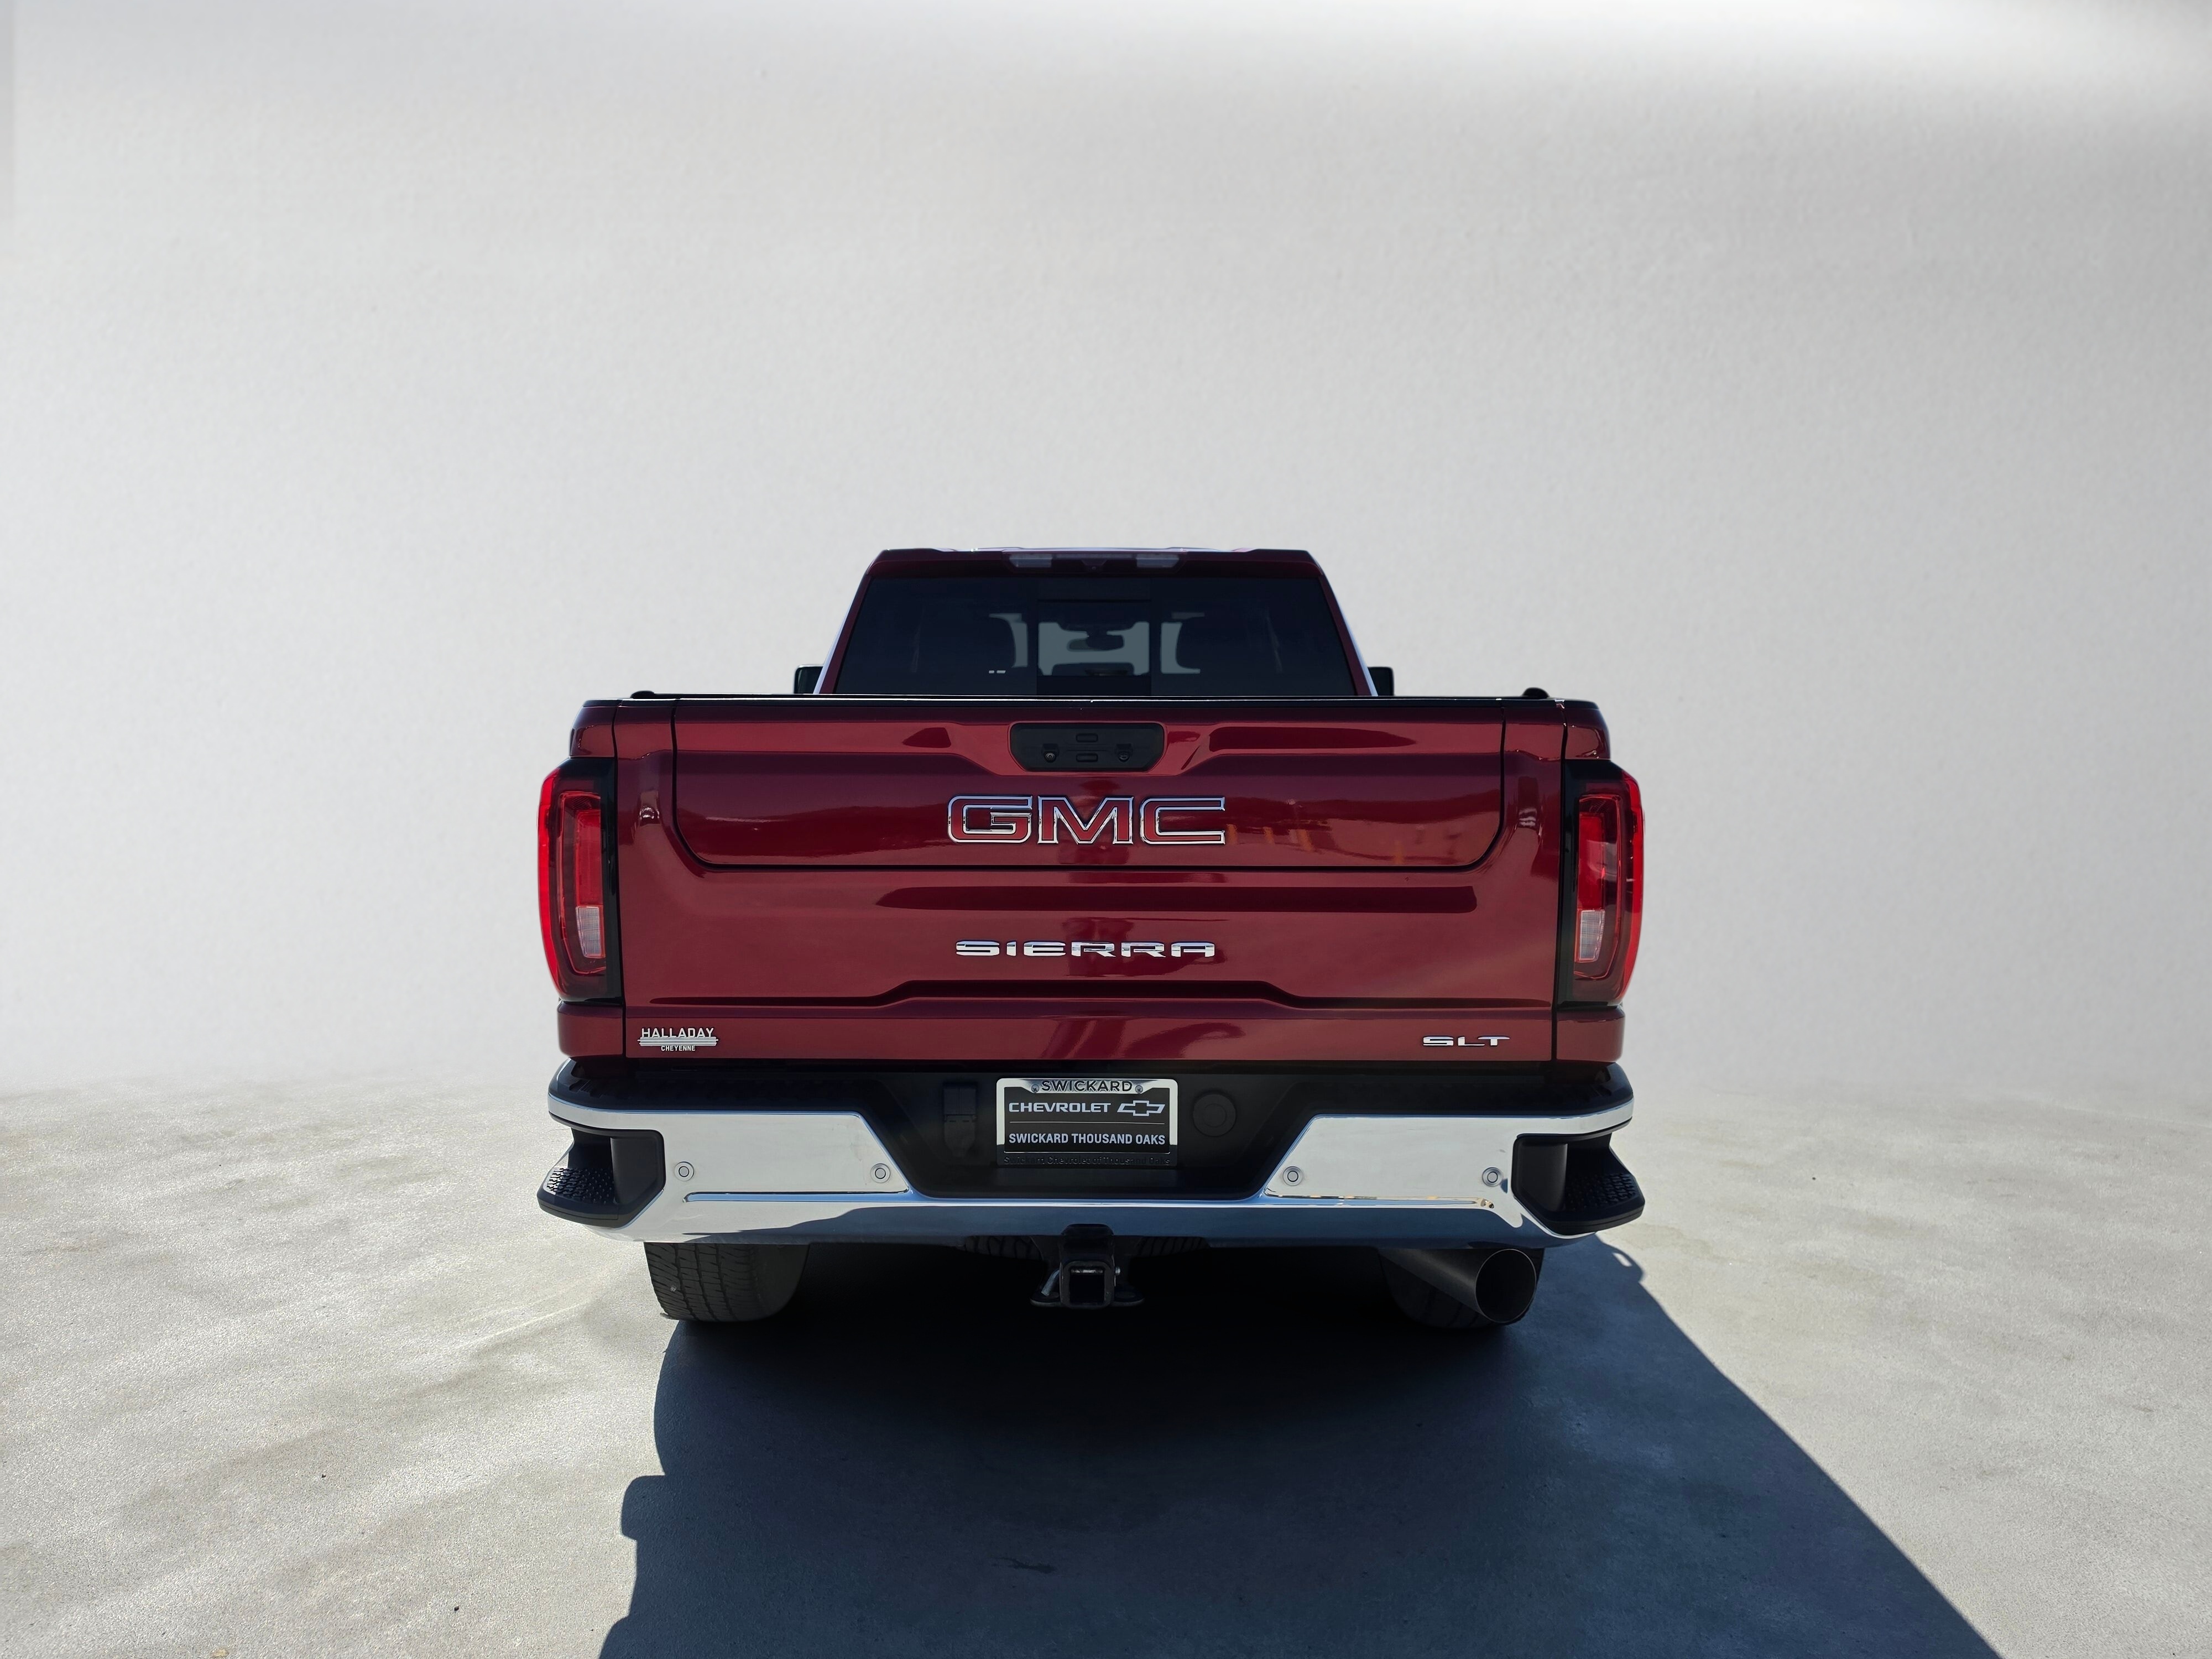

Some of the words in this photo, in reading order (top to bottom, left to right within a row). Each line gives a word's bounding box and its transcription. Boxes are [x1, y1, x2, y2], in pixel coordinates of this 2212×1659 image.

[947, 795, 1225, 845] GMC
[956, 941, 1215, 958] SIERRA
[641, 1027, 714, 1038] HALLADAY
[1423, 1036, 1510, 1046] SLT
[1041, 1080, 1133, 1092] SWICKARD
[1009, 1102, 1112, 1113] CHEVROLET
[1009, 1133, 1068, 1144] SWICKARD
[1071, 1134, 1133, 1144] THOUSAND
[1135, 1134, 1165, 1145] OAKS
